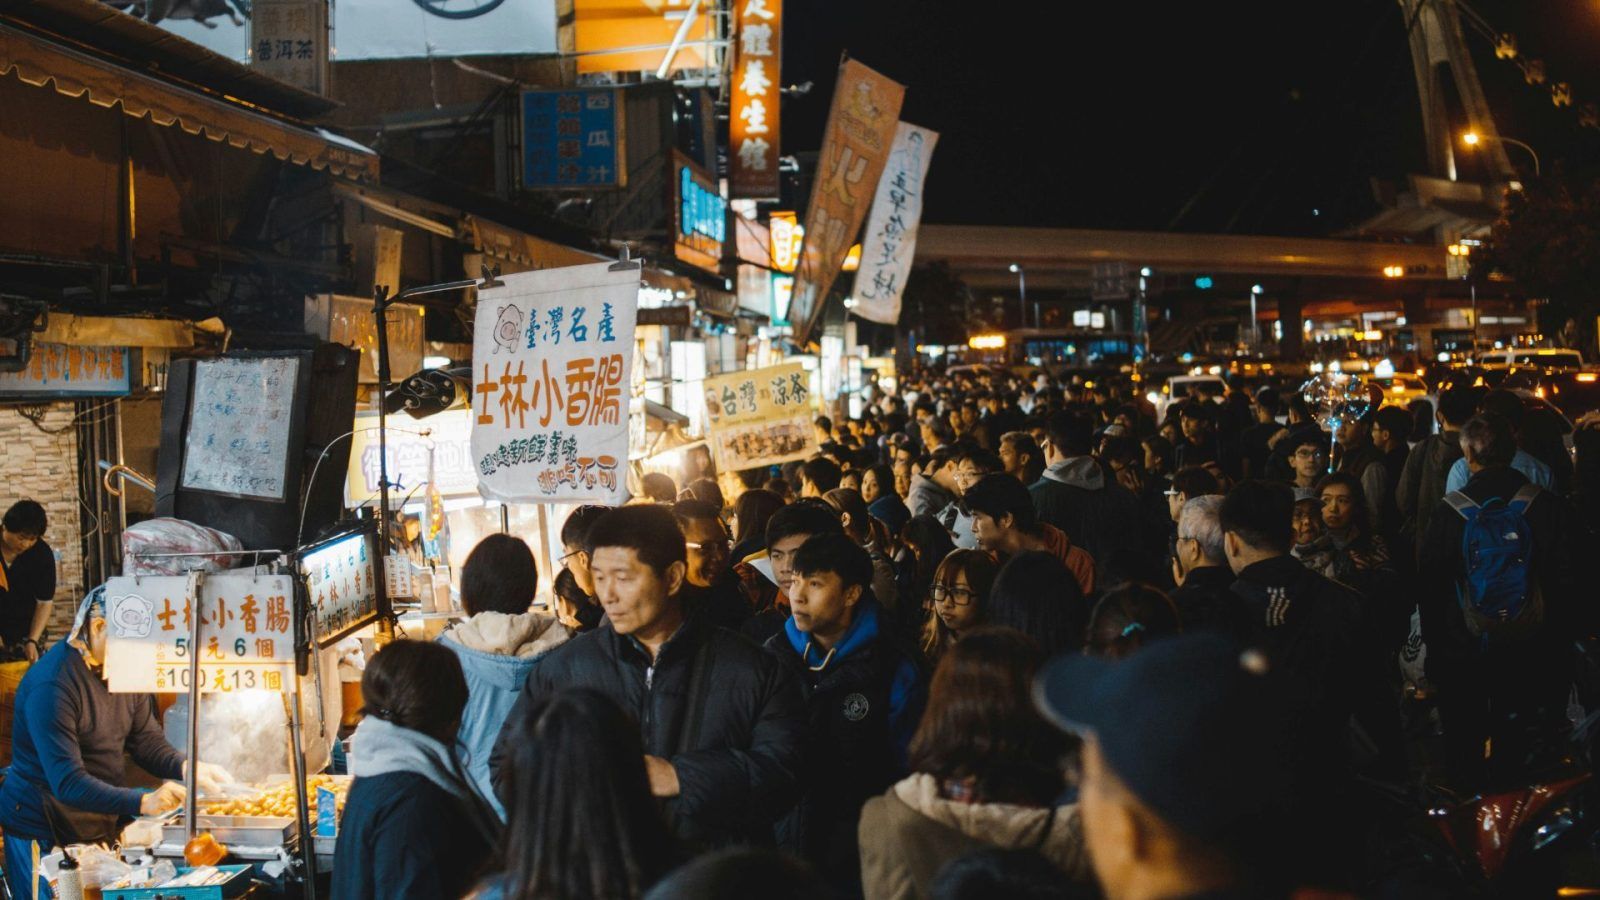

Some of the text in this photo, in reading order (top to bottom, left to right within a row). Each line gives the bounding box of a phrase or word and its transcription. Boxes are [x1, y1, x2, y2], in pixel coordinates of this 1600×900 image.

[258, 39, 313, 61] 普洱茶
[525, 302, 616, 350] 臺灣名產
[476, 353, 624, 429] 士林小香腸
[537, 455, 618, 495] 非吃不可
[317, 564, 373, 612] 士林小香腸
